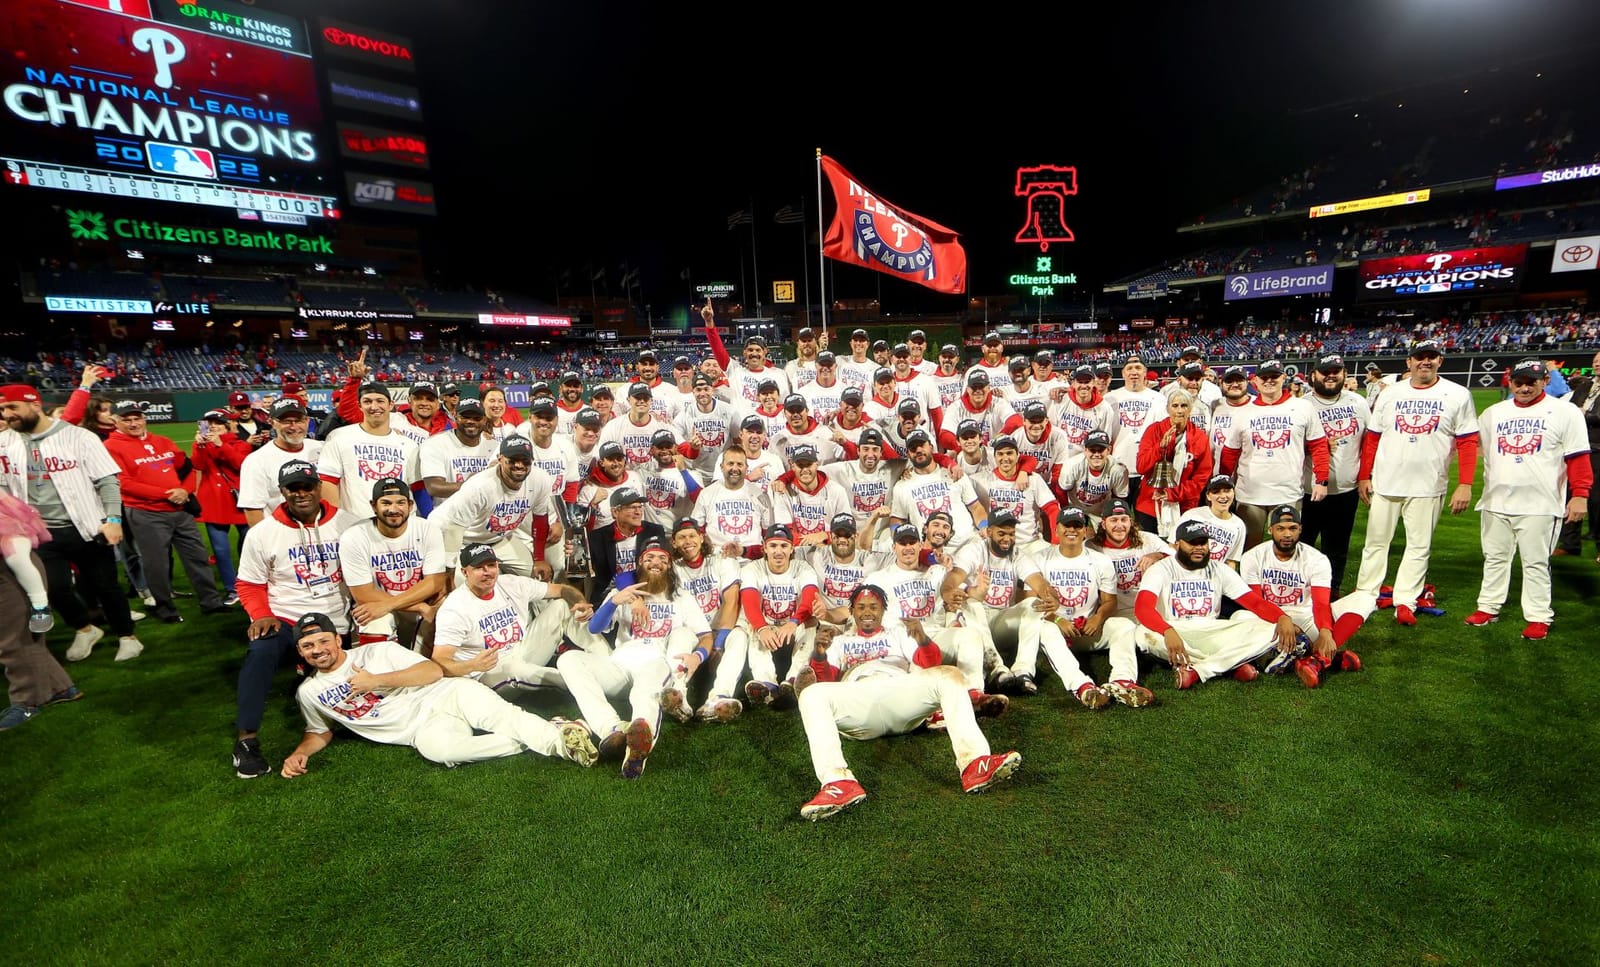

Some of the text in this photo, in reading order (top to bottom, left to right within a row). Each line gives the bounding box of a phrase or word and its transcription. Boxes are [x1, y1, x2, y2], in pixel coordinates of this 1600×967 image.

[179, 4, 291, 38] DRAFTKINGS
[209, 21, 292, 48] SPORTSBOOK
[347, 33, 411, 60] TOYOTA
[132, 27, 186, 89] P
[25, 66, 290, 126] NATIONAL LEAGUE
[3, 83, 318, 162] CHAMPIONS
[96, 141, 260, 177] 20 22
[1541, 165, 1600, 183] StubHub
[279, 199, 288, 211] 0
[294, 201, 304, 213] 0
[311, 203, 319, 214] 3
[113, 218, 334, 254] Citizens Bank Park
[1366, 268, 1514, 289] CHAMPIONS
[1377, 264, 1502, 279] NATIONAL LEAGUE
[1010, 273, 1077, 285] Citizens Bank
[1253, 272, 1327, 291] LifeBrand
[1032, 286, 1054, 296] Park
[50, 299, 210, 314] DENTISTRY for LIFE
[307, 309, 377, 319] KLYRRUM.COM
[1395, 400, 1444, 412] NATIONAL
[693, 420, 725, 429] NATIONAL
[1061, 412, 1093, 429] NATIONAL
[1215, 416, 1232, 424] NATI
[1250, 416, 1293, 428] NATIONAL
[1497, 419, 1547, 433] NATIONAL
[623, 436, 650, 444] NATION
[354, 444, 404, 460] NATIONAL
[362, 454, 399, 463] LEAGUE
[533, 460, 565, 470] ATIONAL
[852, 481, 888, 492] NATIONAL
[912, 481, 951, 497] NATIONAL
[989, 488, 1026, 499] NATIONAL
[918, 491, 946, 500] LEAGUE
[716, 501, 754, 512] NATIONAL
[371, 550, 423, 567] NATIONAL
[380, 561, 417, 572] LEAGUE
[824, 564, 864, 578] NATIONAL
[988, 570, 1014, 581] TIONAL
[1050, 571, 1091, 583] NATIONAL
[1263, 568, 1304, 584] NATIONAL
[1268, 578, 1299, 587] LEAGUE
[893, 580, 936, 597] NATIONAL
[902, 590, 930, 599] LEAGUE
[1171, 581, 1214, 594] NATIONAL
[1175, 590, 1208, 598] LEAGUE
[479, 607, 517, 630] NATIONAL
